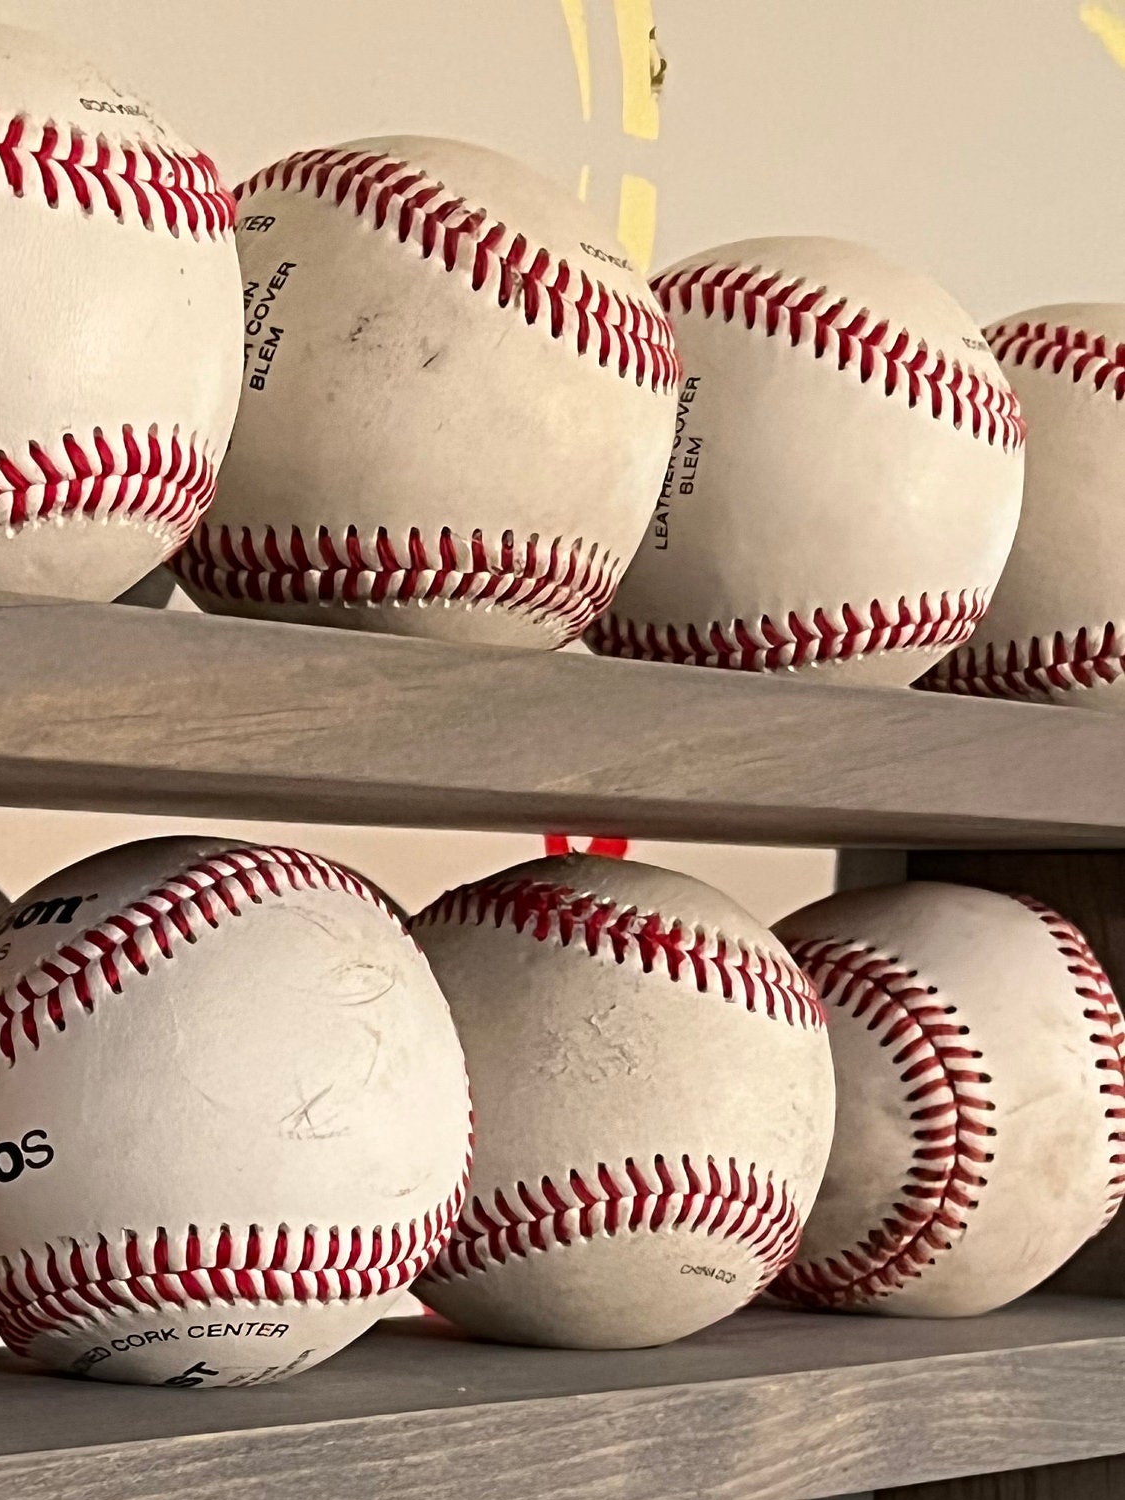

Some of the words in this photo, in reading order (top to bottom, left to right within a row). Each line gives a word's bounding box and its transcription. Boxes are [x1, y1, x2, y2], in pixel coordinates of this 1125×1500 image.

[246, 261, 298, 336] COVER
[249, 326, 285, 392] BLEM
[679, 436, 704, 496] BLEM
[111, 1327, 180, 1352] CORK
[187, 1321, 290, 1339] CENTER
